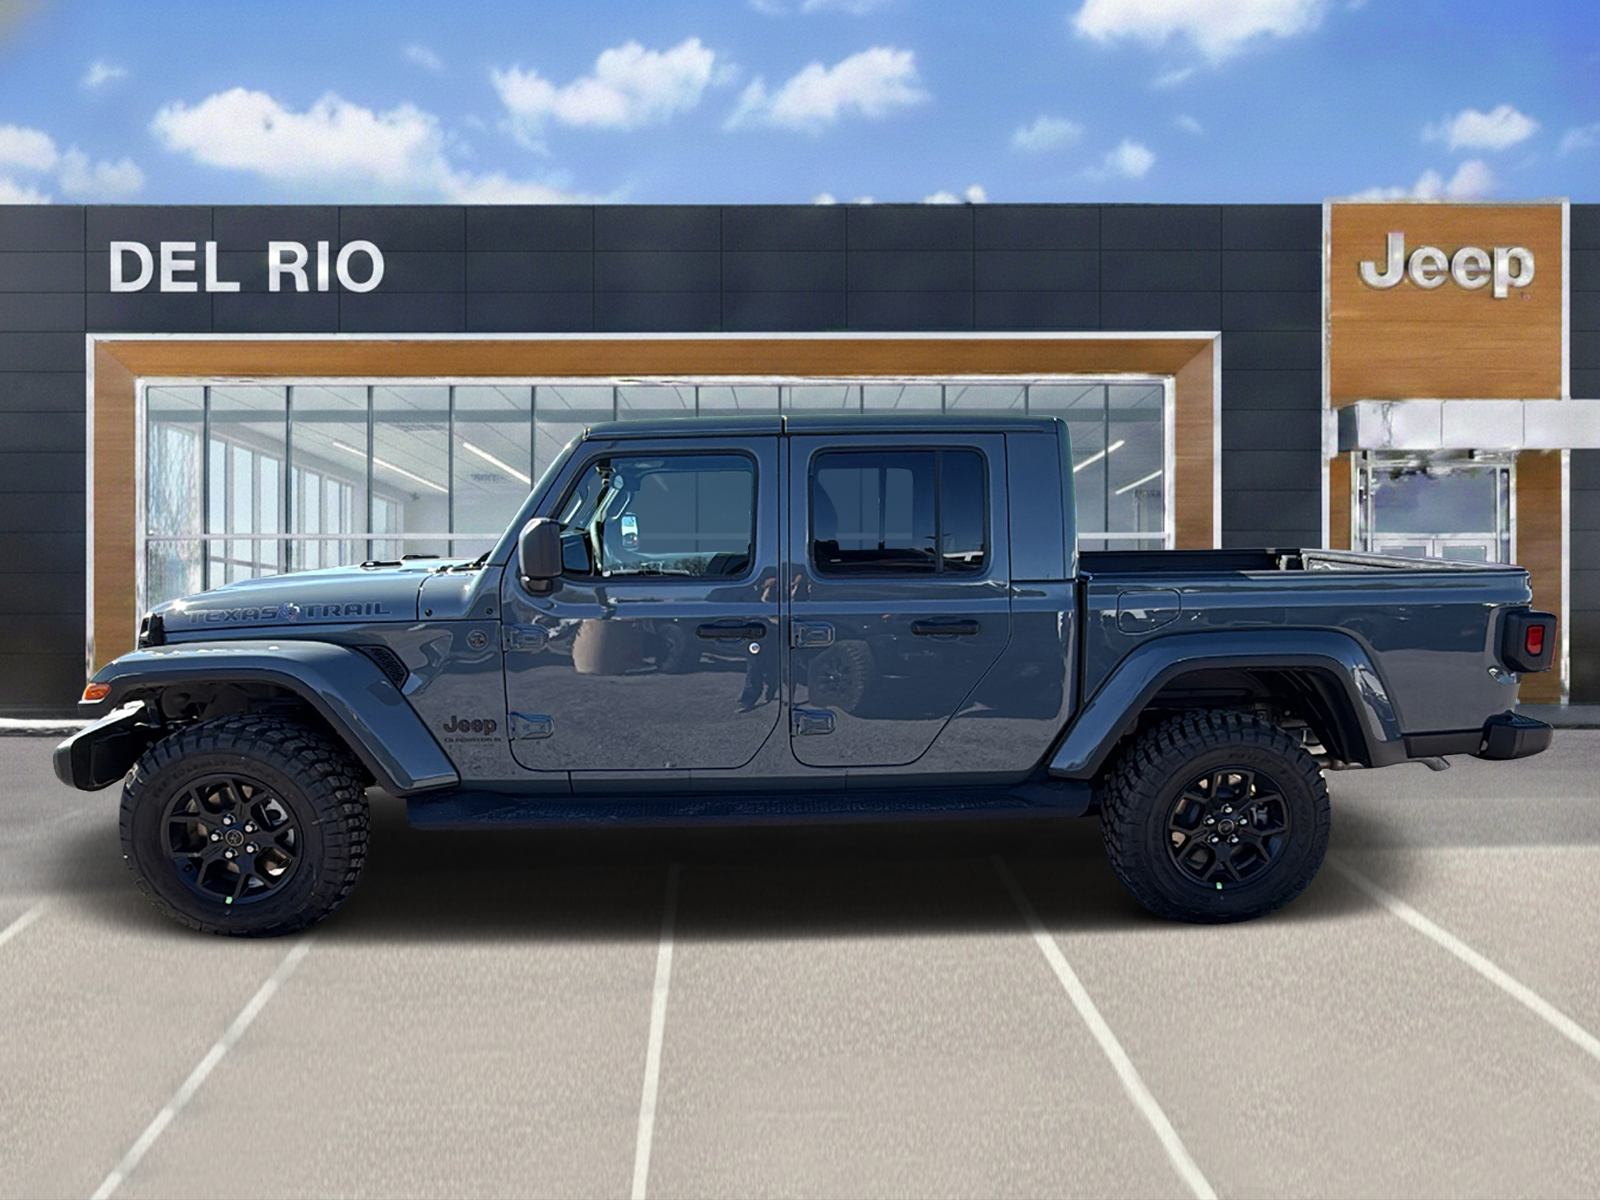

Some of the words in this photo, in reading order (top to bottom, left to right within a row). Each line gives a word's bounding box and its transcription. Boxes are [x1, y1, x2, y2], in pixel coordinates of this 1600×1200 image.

[109, 240, 241, 293] DEL
[267, 239, 385, 293] RIO
[1359, 230, 1536, 299] Jeep
[185, 604, 279, 624] TEXAS
[299, 602, 392, 619] TRAIL
[442, 715, 498, 736] Jeep
